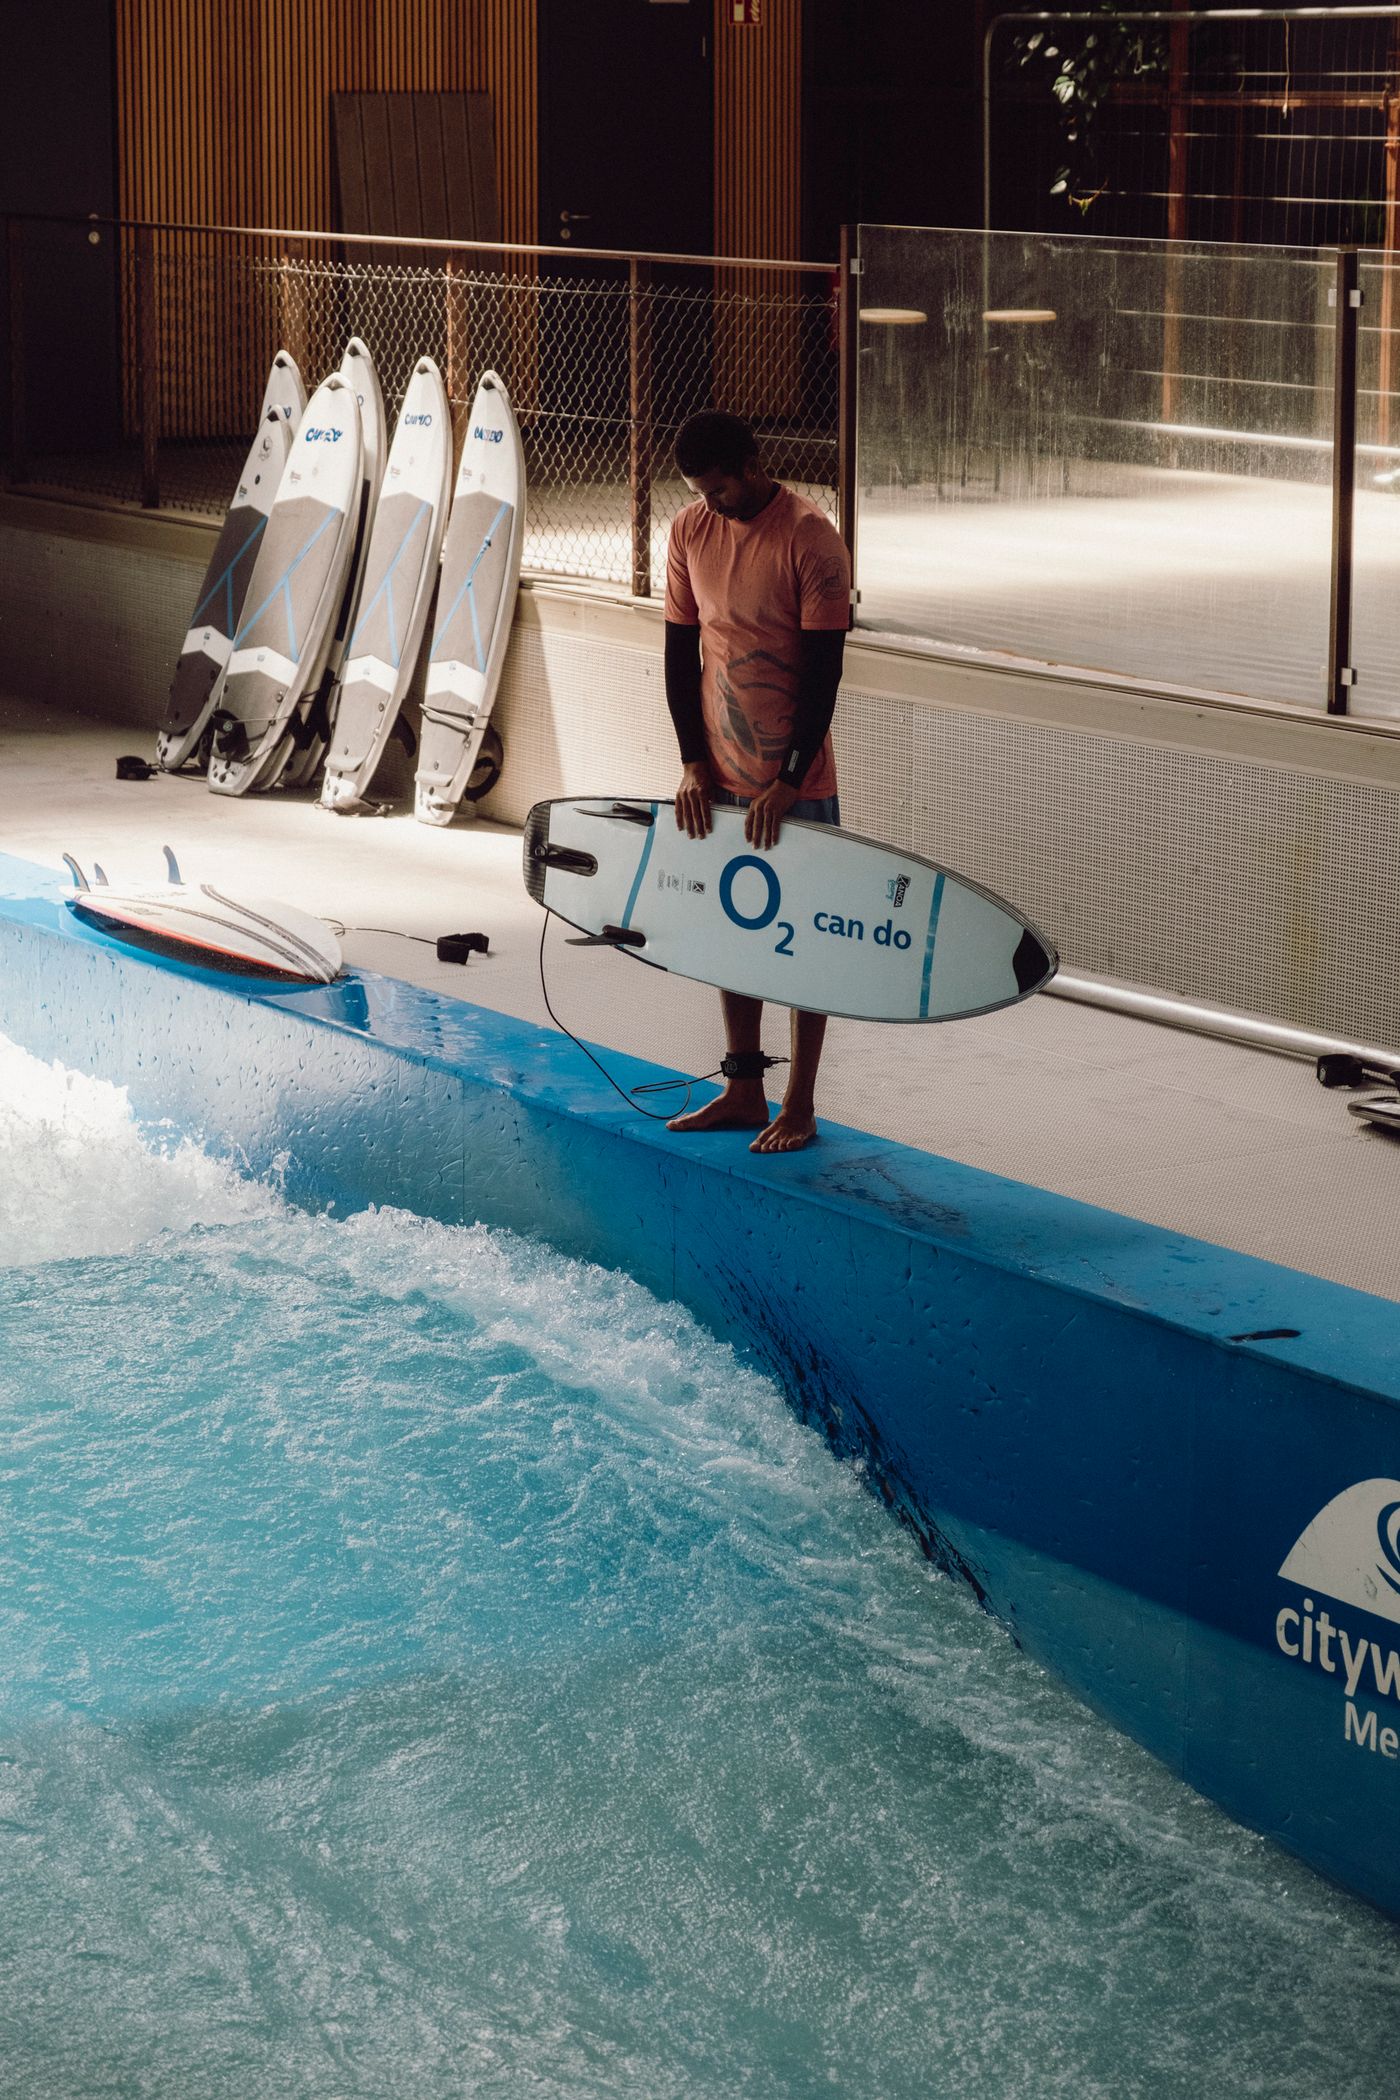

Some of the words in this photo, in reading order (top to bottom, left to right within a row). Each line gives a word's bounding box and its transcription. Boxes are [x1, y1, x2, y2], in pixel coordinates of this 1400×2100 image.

[893, 873, 911, 908] KANOA
[813, 911, 864, 941] can
[873, 919, 912, 950] do
[1344, 1700, 1400, 1759] Me
